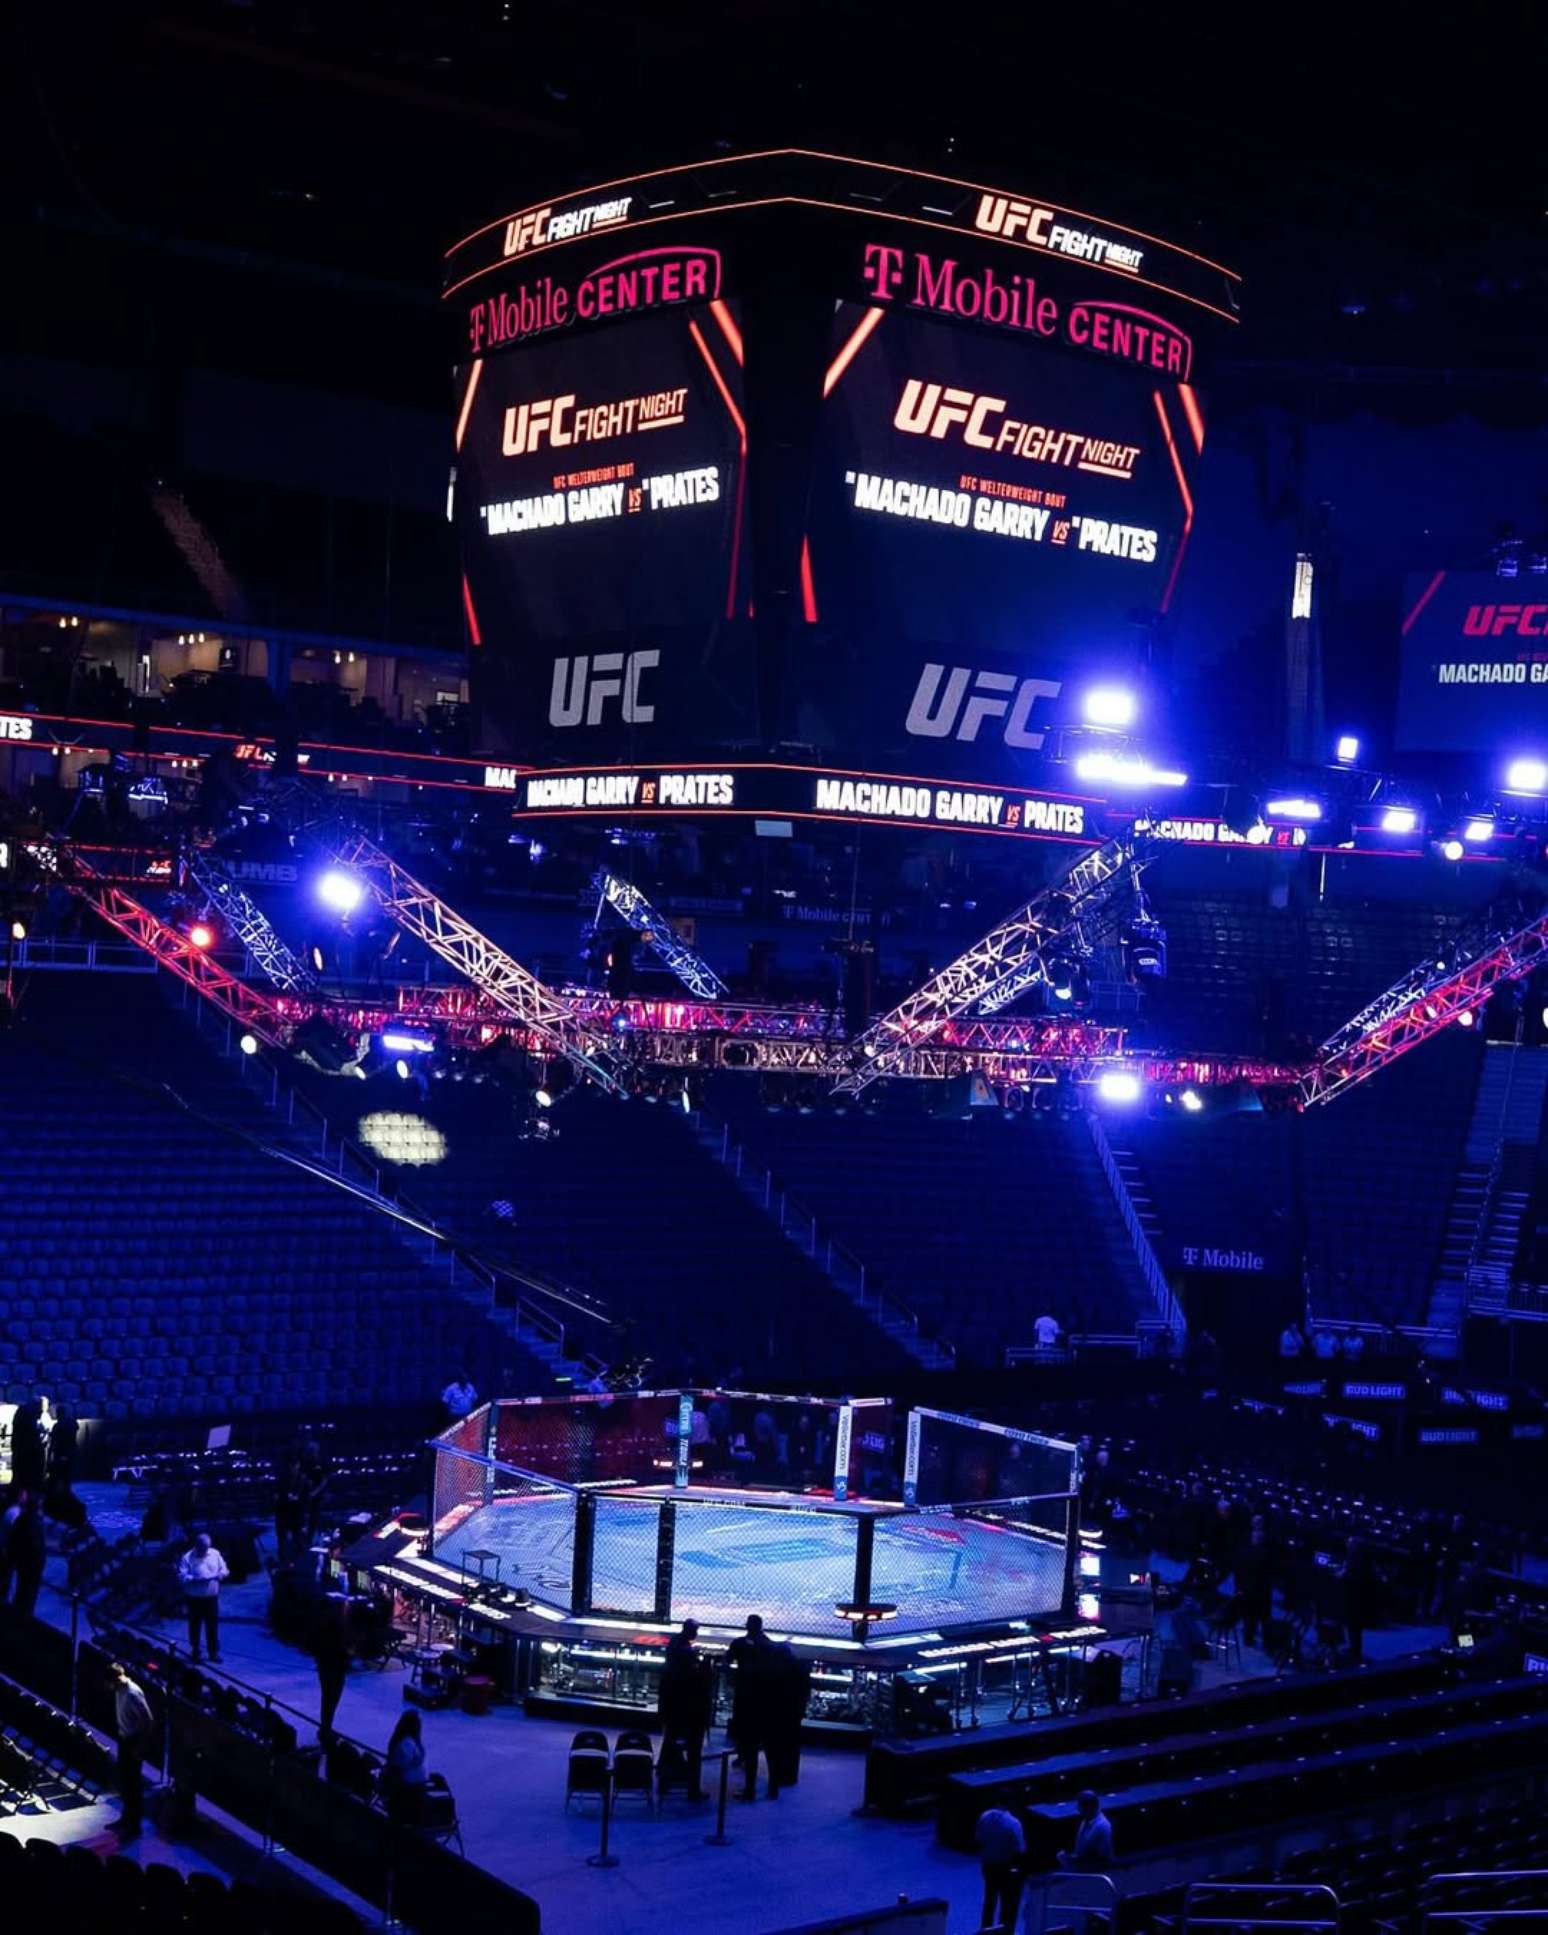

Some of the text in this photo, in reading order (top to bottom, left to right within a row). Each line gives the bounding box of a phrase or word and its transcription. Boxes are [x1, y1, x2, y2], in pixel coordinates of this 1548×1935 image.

[503, 207, 551, 256] UFC
[547, 208, 594, 242] FIGHT
[975, 193, 1144, 267] UFC FIGHT NIGHT
[487, 276, 569, 346] Mobile
[577, 258, 707, 318] CENTER
[914, 253, 1060, 336] Mobile
[1068, 306, 1184, 374] CENTER
[502, 388, 688, 457] UFC FIGHT NIGHT
[893, 378, 1140, 471] UFC FIGHT NIGHT
[486, 491, 566, 536] MACHADO
[567, 483, 626, 524] GARRY
[649, 465, 720, 511] PRATES
[853, 474, 971, 527] MACHADO
[973, 496, 1051, 543] GARRY
[1077, 516, 1159, 563] PRATES
[959, 474, 978, 492] UFC
[979, 478, 1044, 503] WELTERWEIGHT
[1462, 604, 1547, 636] UFC
[548, 649, 661, 728] UFC
[905, 661, 1063, 750] UFC
[1438, 663, 1526, 684] MACHADO
[586, 776, 639, 805] GARRY
[658, 774, 735, 806] PRATES
[815, 778, 931, 818] MACHADO
[935, 789, 1004, 825] GARRY
[1023, 800, 1085, 834] PRATES
[1202, 1247, 1264, 1270] Mobile
[1370, 1385, 1402, 1397] LIGHT
